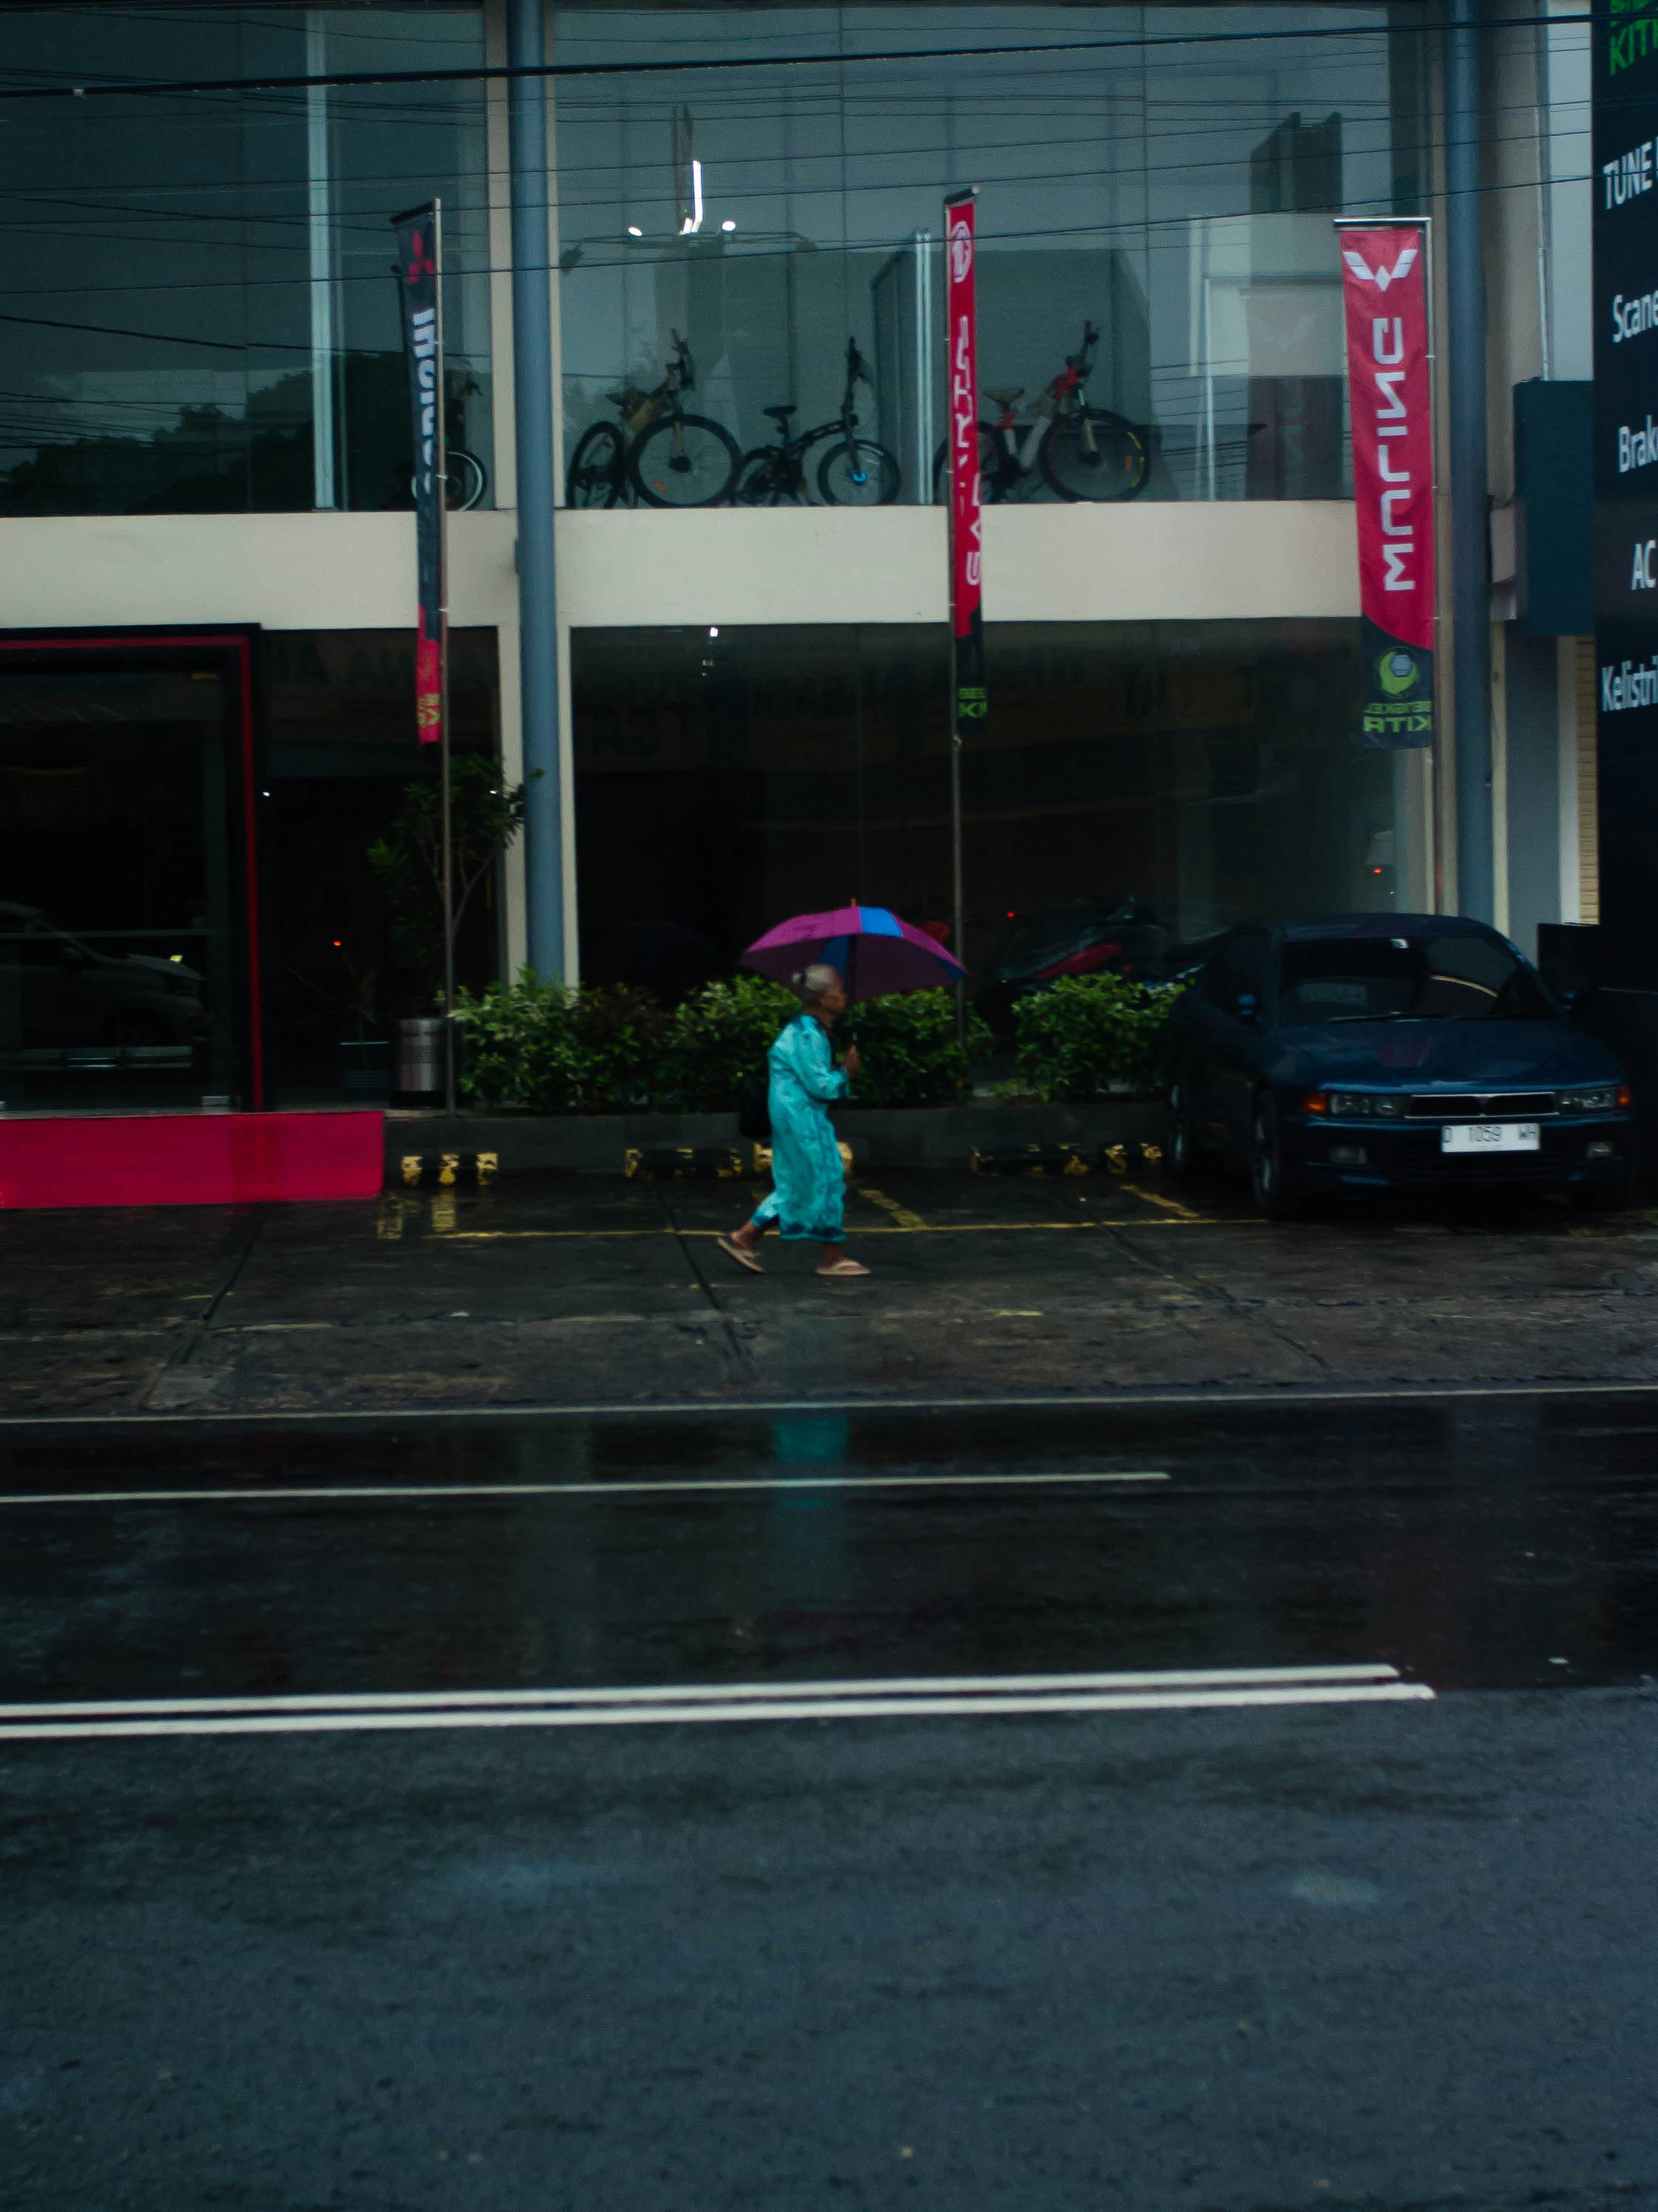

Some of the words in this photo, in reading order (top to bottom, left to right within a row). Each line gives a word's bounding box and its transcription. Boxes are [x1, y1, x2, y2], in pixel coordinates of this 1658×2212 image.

[1603, 141, 1653, 210] TUNE
[1617, 414, 1658, 473] Brak
[1631, 539, 1657, 590] AC
